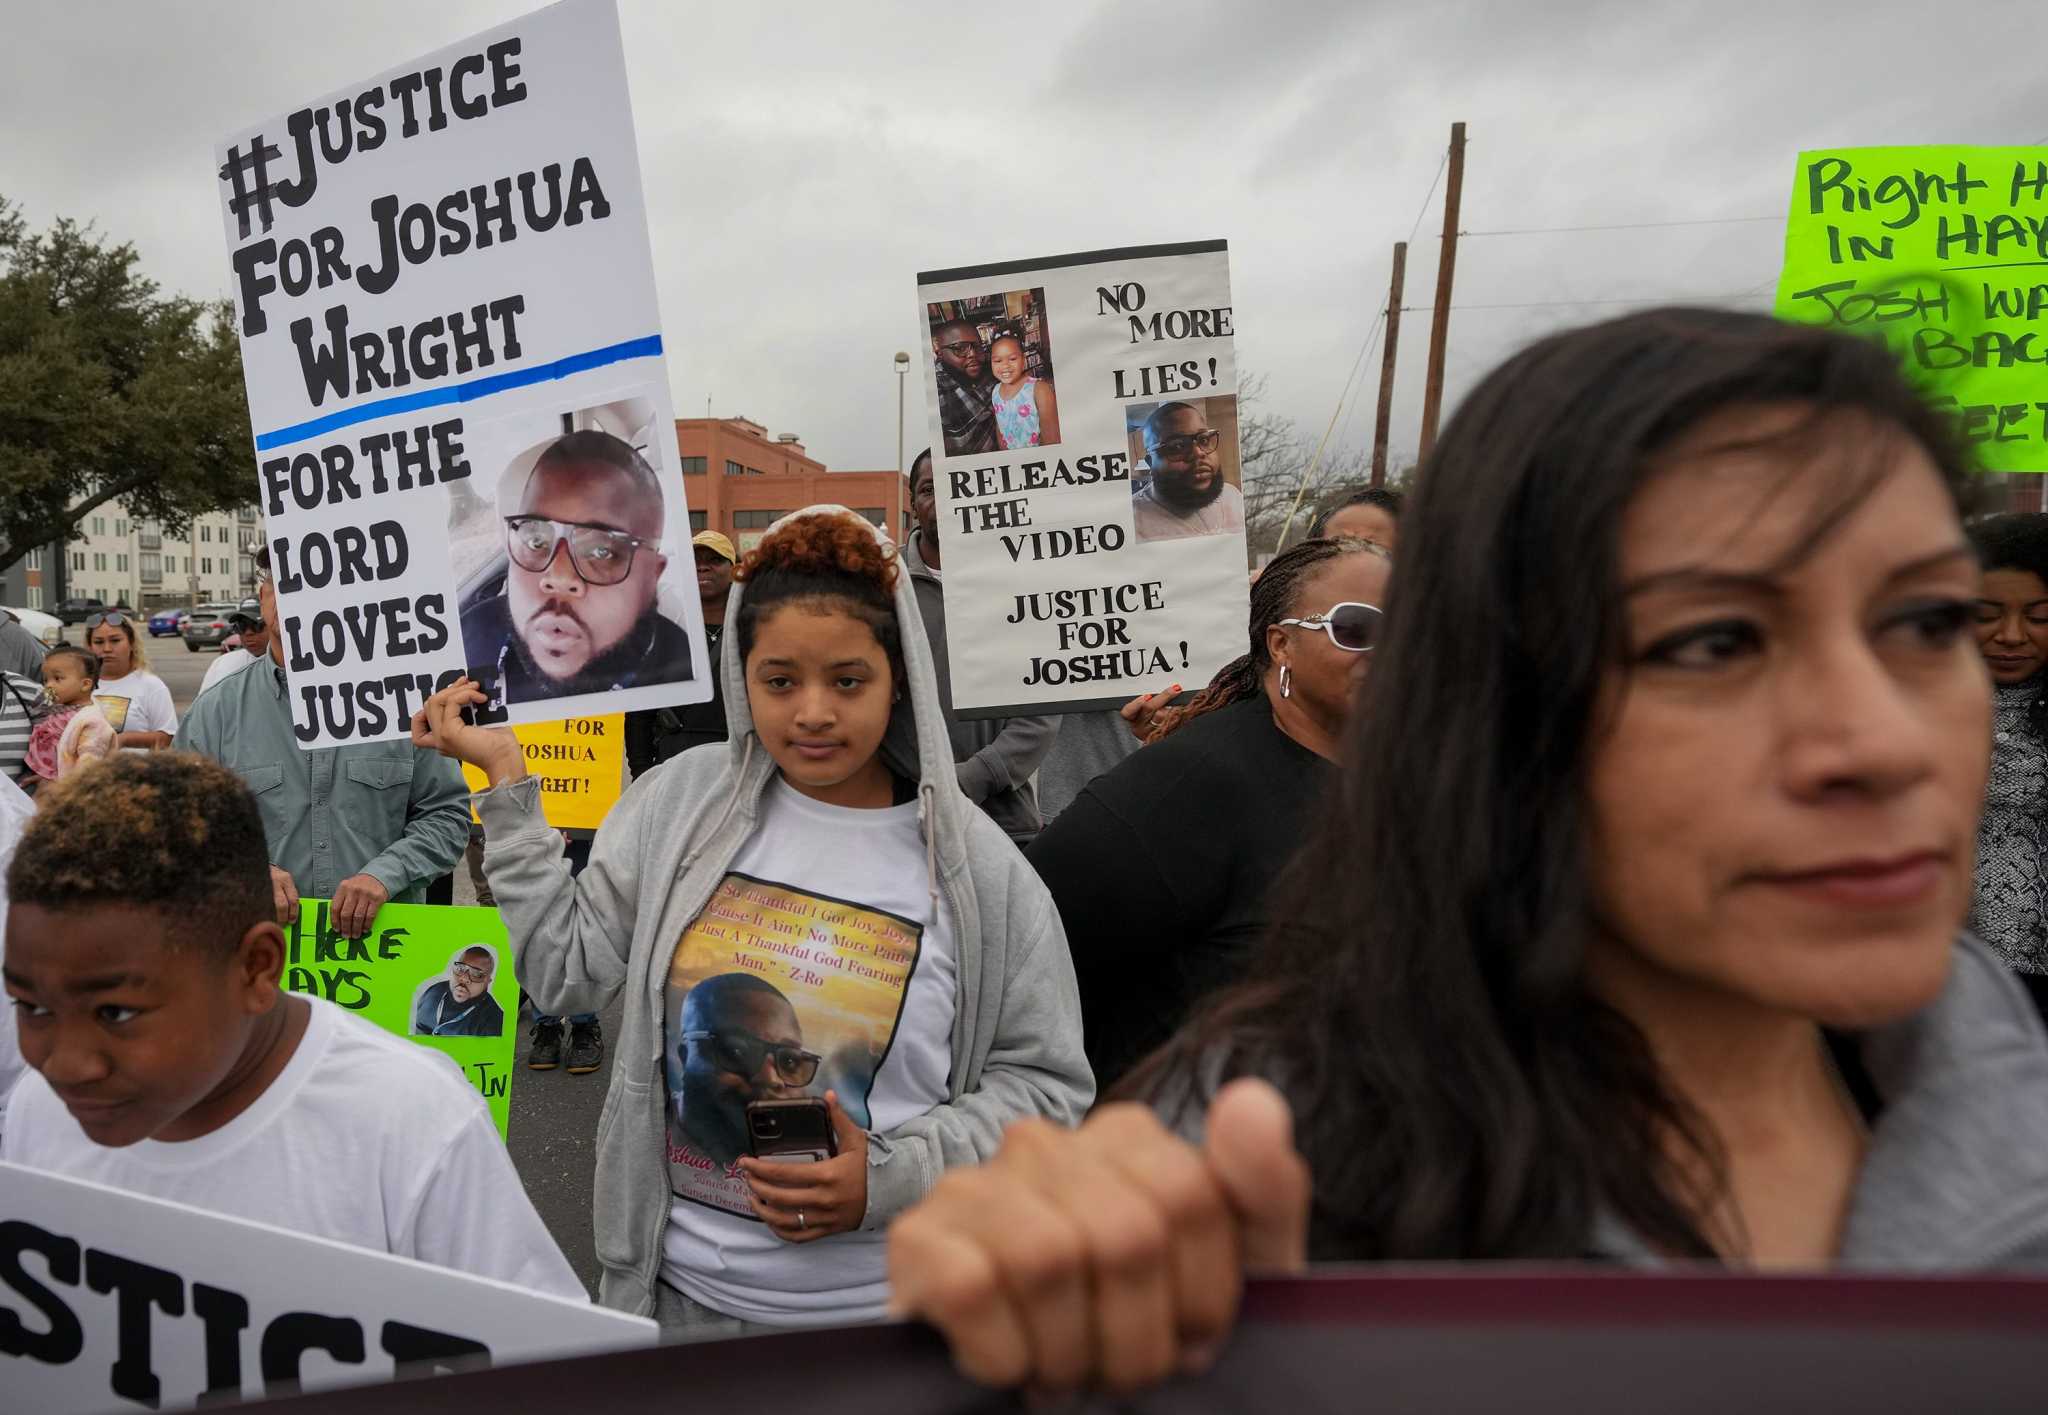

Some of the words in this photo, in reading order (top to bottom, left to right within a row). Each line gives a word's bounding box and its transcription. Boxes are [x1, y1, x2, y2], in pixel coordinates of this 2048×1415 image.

[219, 37, 527, 240] #JUSTICE
[233, 226, 351, 337] FOR
[356, 157, 611, 294] JOSHUA
[1827, 224, 1894, 264] IN
[1096, 282, 1146, 316] NO
[1792, 280, 1949, 325] JOSH
[1128, 307, 1235, 344] MORE
[290, 295, 525, 406] WRIGHT
[1912, 328, 2048, 370] BAC
[1112, 357, 1218, 399] LIES!
[262, 444, 362, 516] FOR
[361, 418, 472, 494] THE
[948, 452, 1129, 500] RELEASE
[954, 498, 1032, 534] THE
[273, 519, 409, 595] LORD
[1000, 524, 1125, 563] VIDEO
[1007, 581, 1165, 624] JUSTICE
[285, 593, 449, 673] LOVES
[1057, 617, 1131, 651] FOR
[564, 718, 606, 737] FOR
[540, 776, 590, 793] GHT!
[752, 911, 764, 927] It
[807, 927, 828, 943] No
[831, 933, 869, 952] More
[821, 909, 847, 927] Got
[745, 931, 811, 960] Thankful
[814, 950, 844, 970] God
[846, 958, 903, 989] Fearing
[289, 967, 373, 1010] AYS
